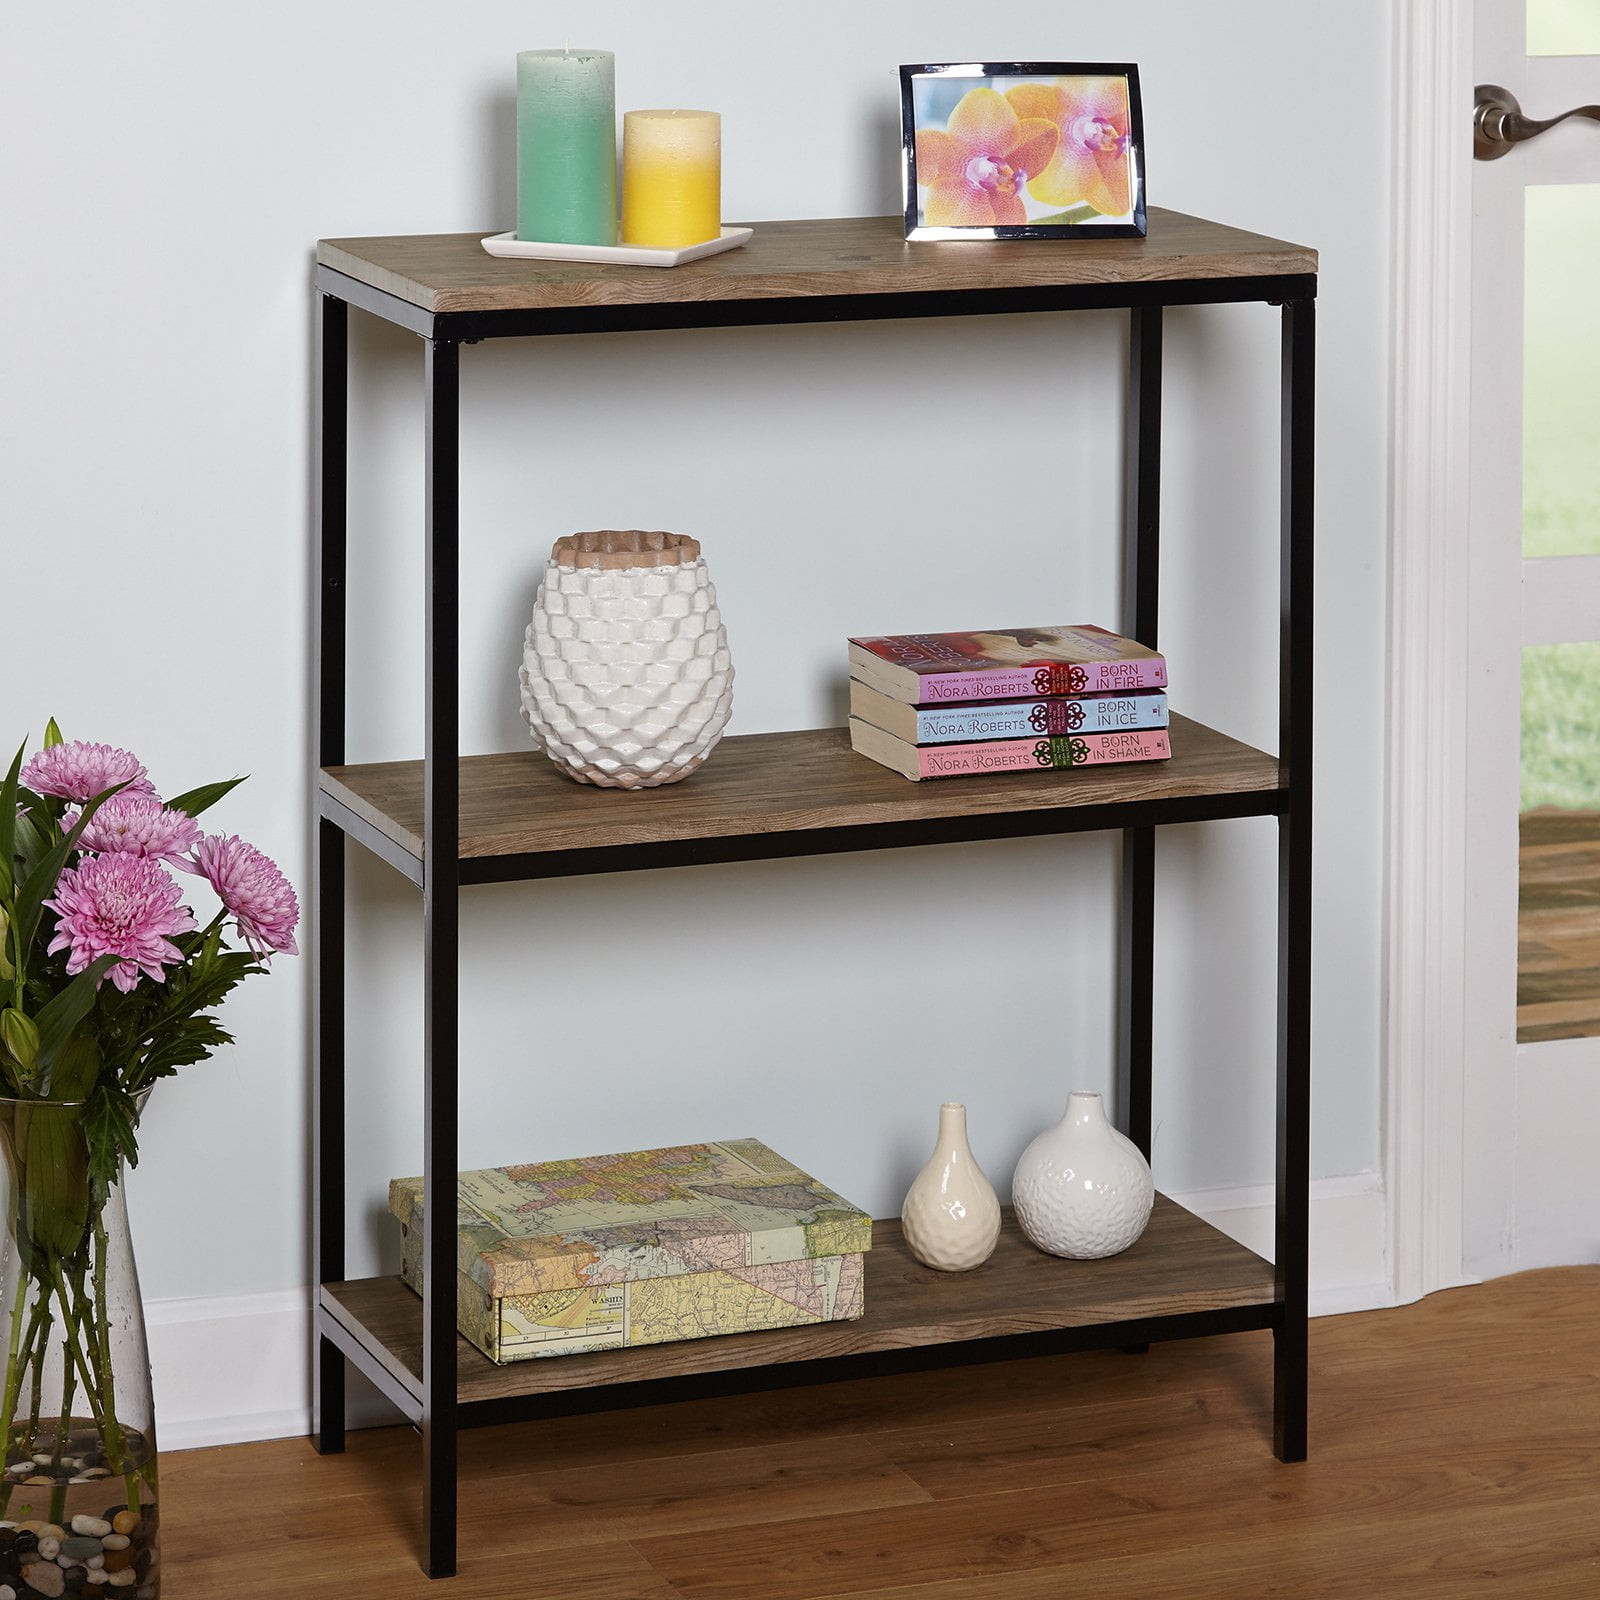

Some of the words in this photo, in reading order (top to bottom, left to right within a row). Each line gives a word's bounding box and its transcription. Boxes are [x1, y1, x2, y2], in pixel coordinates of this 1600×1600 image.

[1100, 664, 1139, 677] BORN
[1096, 678, 1110, 689] IN
[1114, 676, 1144, 688] FIRE
[928, 684, 969, 700] NORA
[972, 682, 1029, 697] ROBERTS
[1098, 700, 1136, 713] BORN
[1097, 715, 1111, 726] IN
[1116, 713, 1138, 725] ICE
[924, 721, 965, 737] NORA
[968, 719, 1026, 735] ROBERTS
[1101, 735, 1140, 748] BORN
[1093, 749, 1105, 760] IN
[1109, 746, 1152, 759] SHAME
[928, 757, 970, 773] NORA
[972, 754, 1030, 769] ROBERTS
